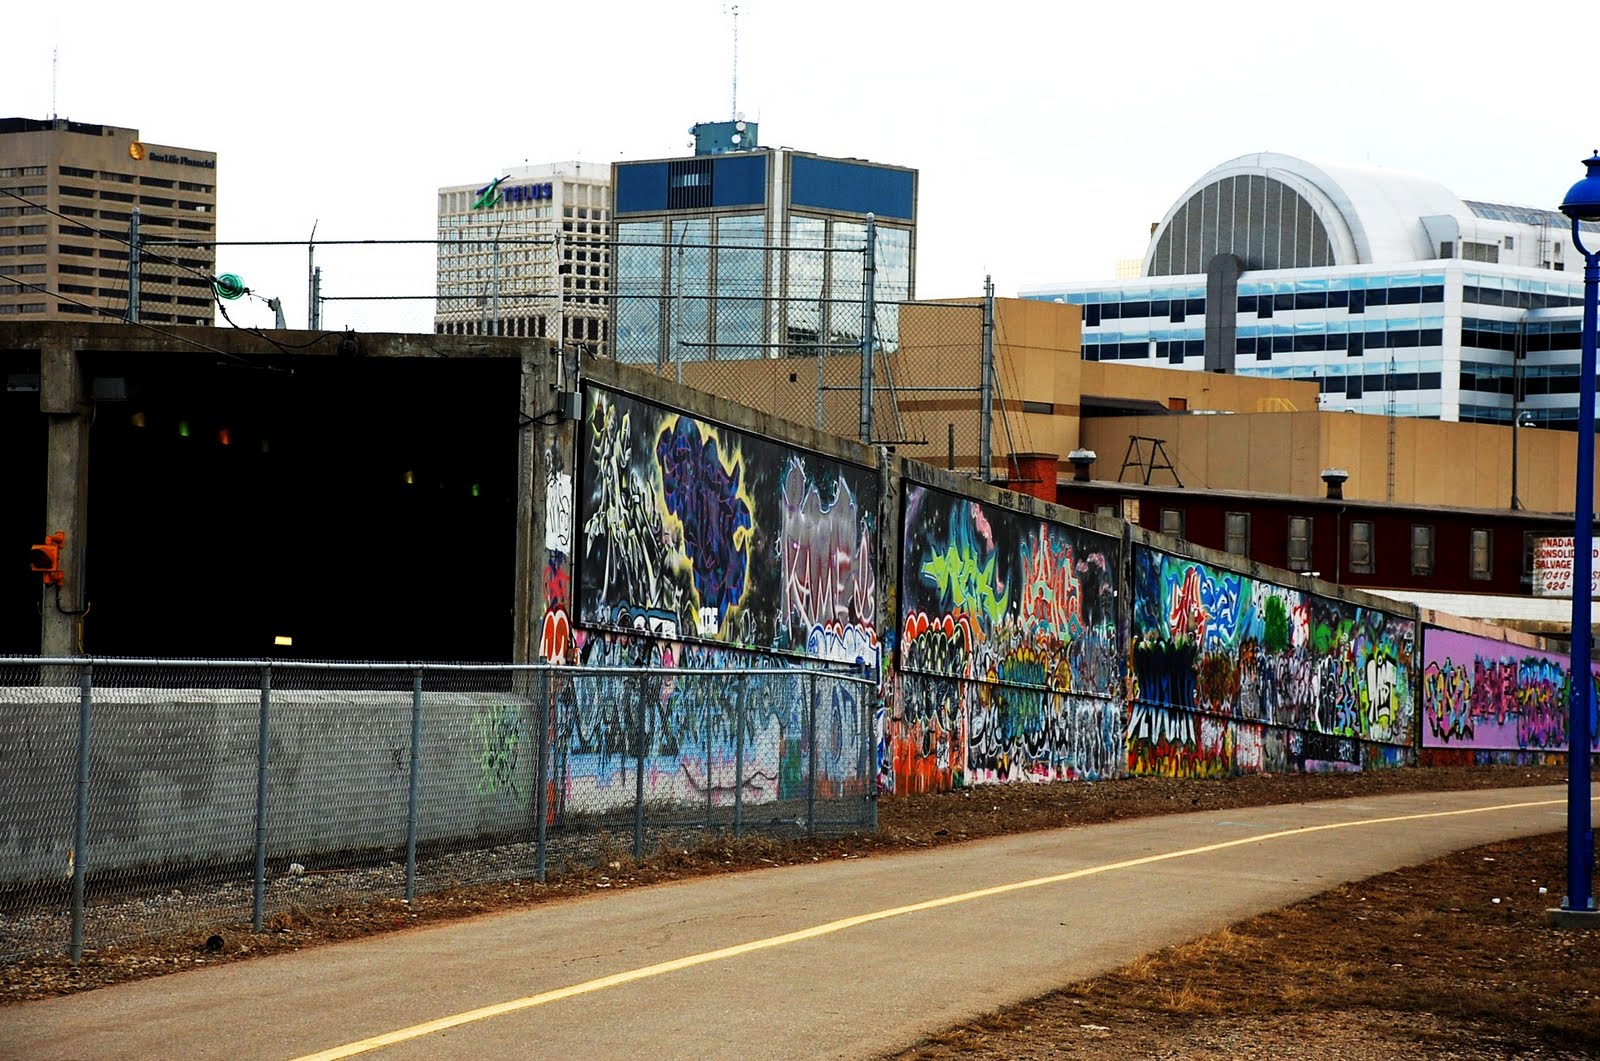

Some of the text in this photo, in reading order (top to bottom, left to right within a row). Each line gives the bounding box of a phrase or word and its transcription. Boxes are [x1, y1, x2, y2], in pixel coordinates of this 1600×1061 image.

[164, 154, 179, 164] Life
[180, 156, 215, 169] Financial
[503, 182, 552, 202] TELUS
[1535, 560, 1572, 569] SALVAGE
